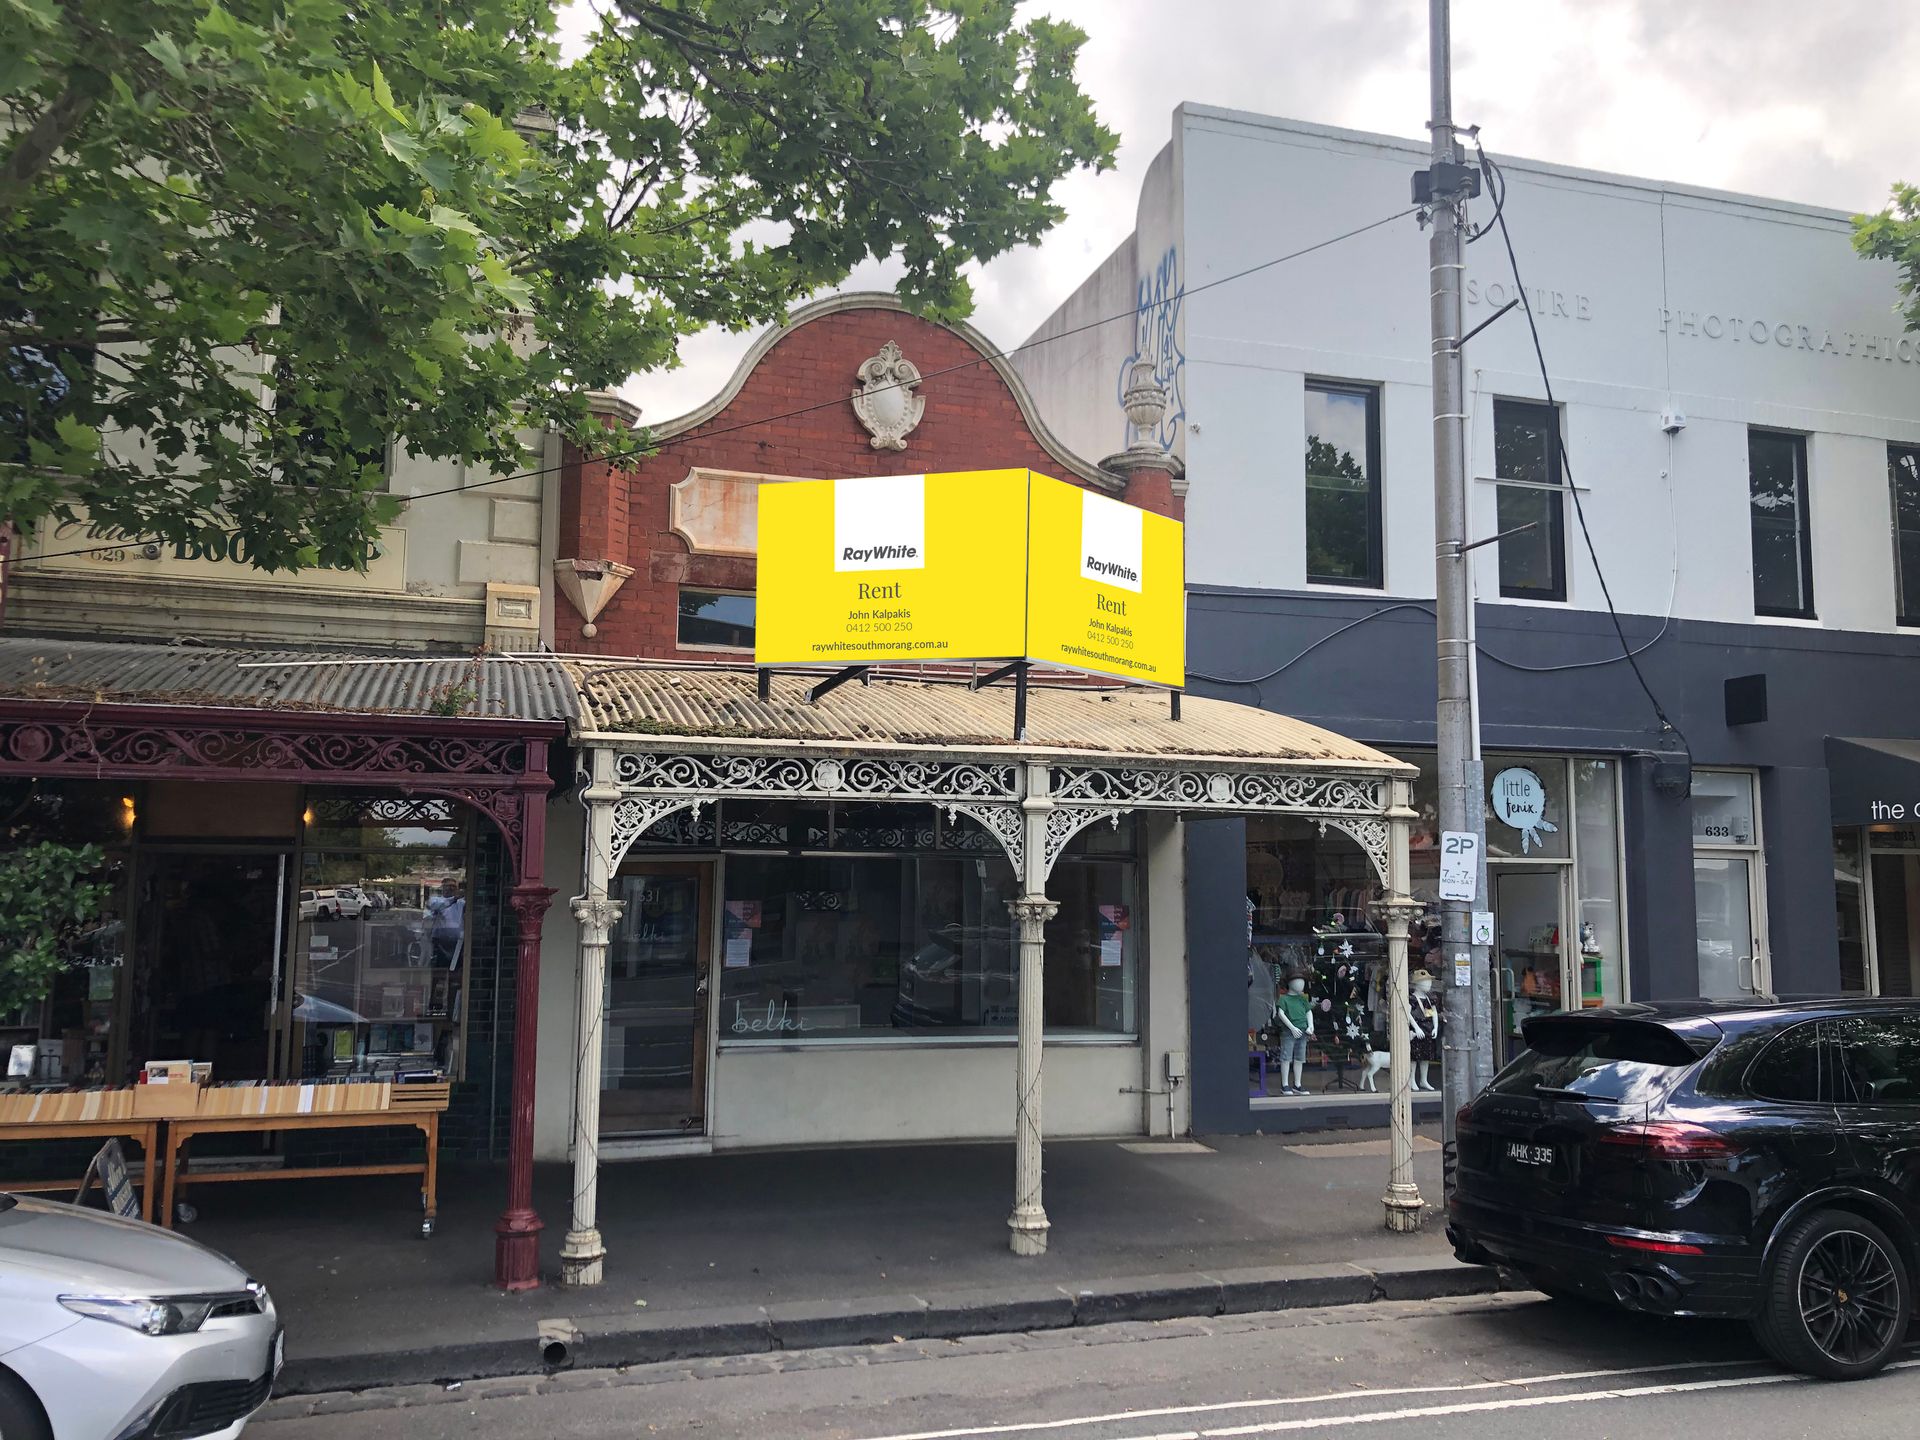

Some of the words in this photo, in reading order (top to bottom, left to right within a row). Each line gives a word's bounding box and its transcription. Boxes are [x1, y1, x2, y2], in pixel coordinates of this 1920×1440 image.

[1466, 280, 1592, 320] SQUIRE
[858, 582, 902, 600] Rent
[848, 610, 870, 620] John
[872, 608, 911, 620] Kalpakis
[1096, 593, 1127, 616] Rent
[846, 624, 871, 633] 0412
[873, 622, 892, 632] 500
[894, 622, 913, 631] 250
[1089, 618, 1105, 629] John
[1106, 622, 1133, 637] Kalpakis
[812, 641, 949, 653] raywhitesouthmorang.com.au
[1087, 631, 1105, 643] 0412
[1107, 636, 1120, 646] 500
[1121, 640, 1134, 650] 250
[1061, 643, 1157, 672] raywhitesouthmorang.com.au
[1503, 778, 1530, 797] little
[1871, 800, 1905, 820] the
[1705, 826, 1729, 837] 633
[1445, 837, 1474, 855] 2P
[732, 1000, 816, 1033] belki
